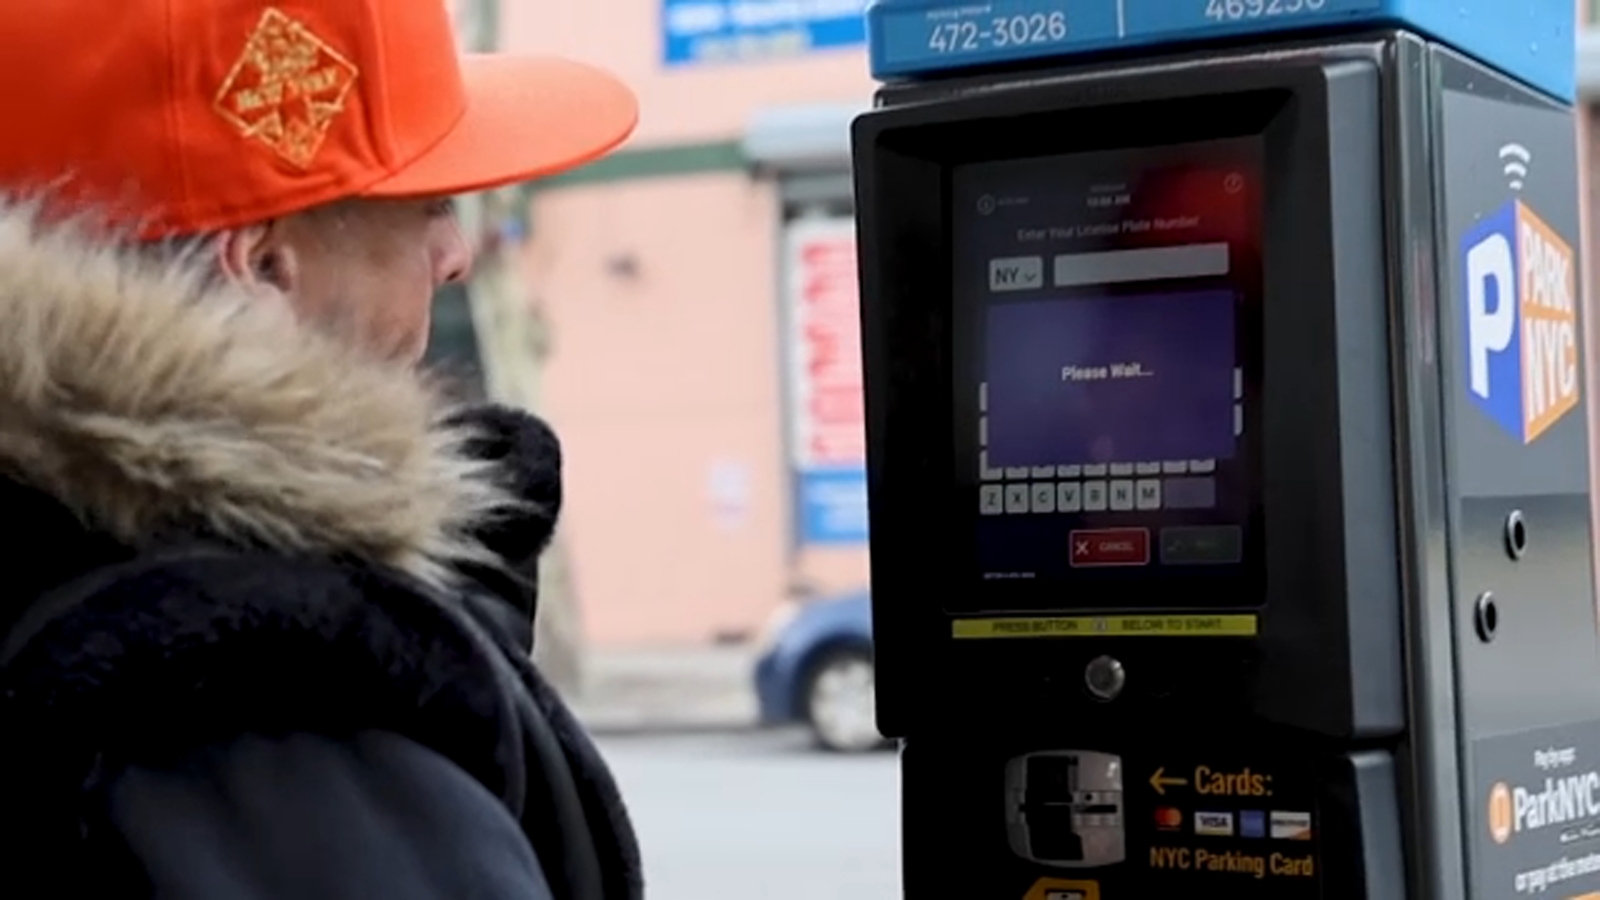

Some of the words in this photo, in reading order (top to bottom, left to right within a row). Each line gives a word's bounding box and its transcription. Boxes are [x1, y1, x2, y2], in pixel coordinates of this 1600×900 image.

[928, 11, 1067, 52] 472-3026
[995, 267, 1020, 284] NY
[1520, 217, 1572, 315] PARK
[1061, 365, 1107, 382] Please
[1521, 317, 1575, 422] NYC
[1142, 487, 1155, 500] M
[1032, 619, 1078, 632] BUTTON
[1122, 619, 1163, 631] BELOW
[1167, 618, 1182, 630] TO
[1185, 617, 1222, 630] START
[1194, 765, 1273, 797] Cards:
[1512, 770, 1600, 833] ParkNYC
[1200, 815, 1229, 828] VISA
[1149, 845, 1191, 870] NYC
[1194, 847, 1264, 880] Parking
[1269, 851, 1314, 877] Card
